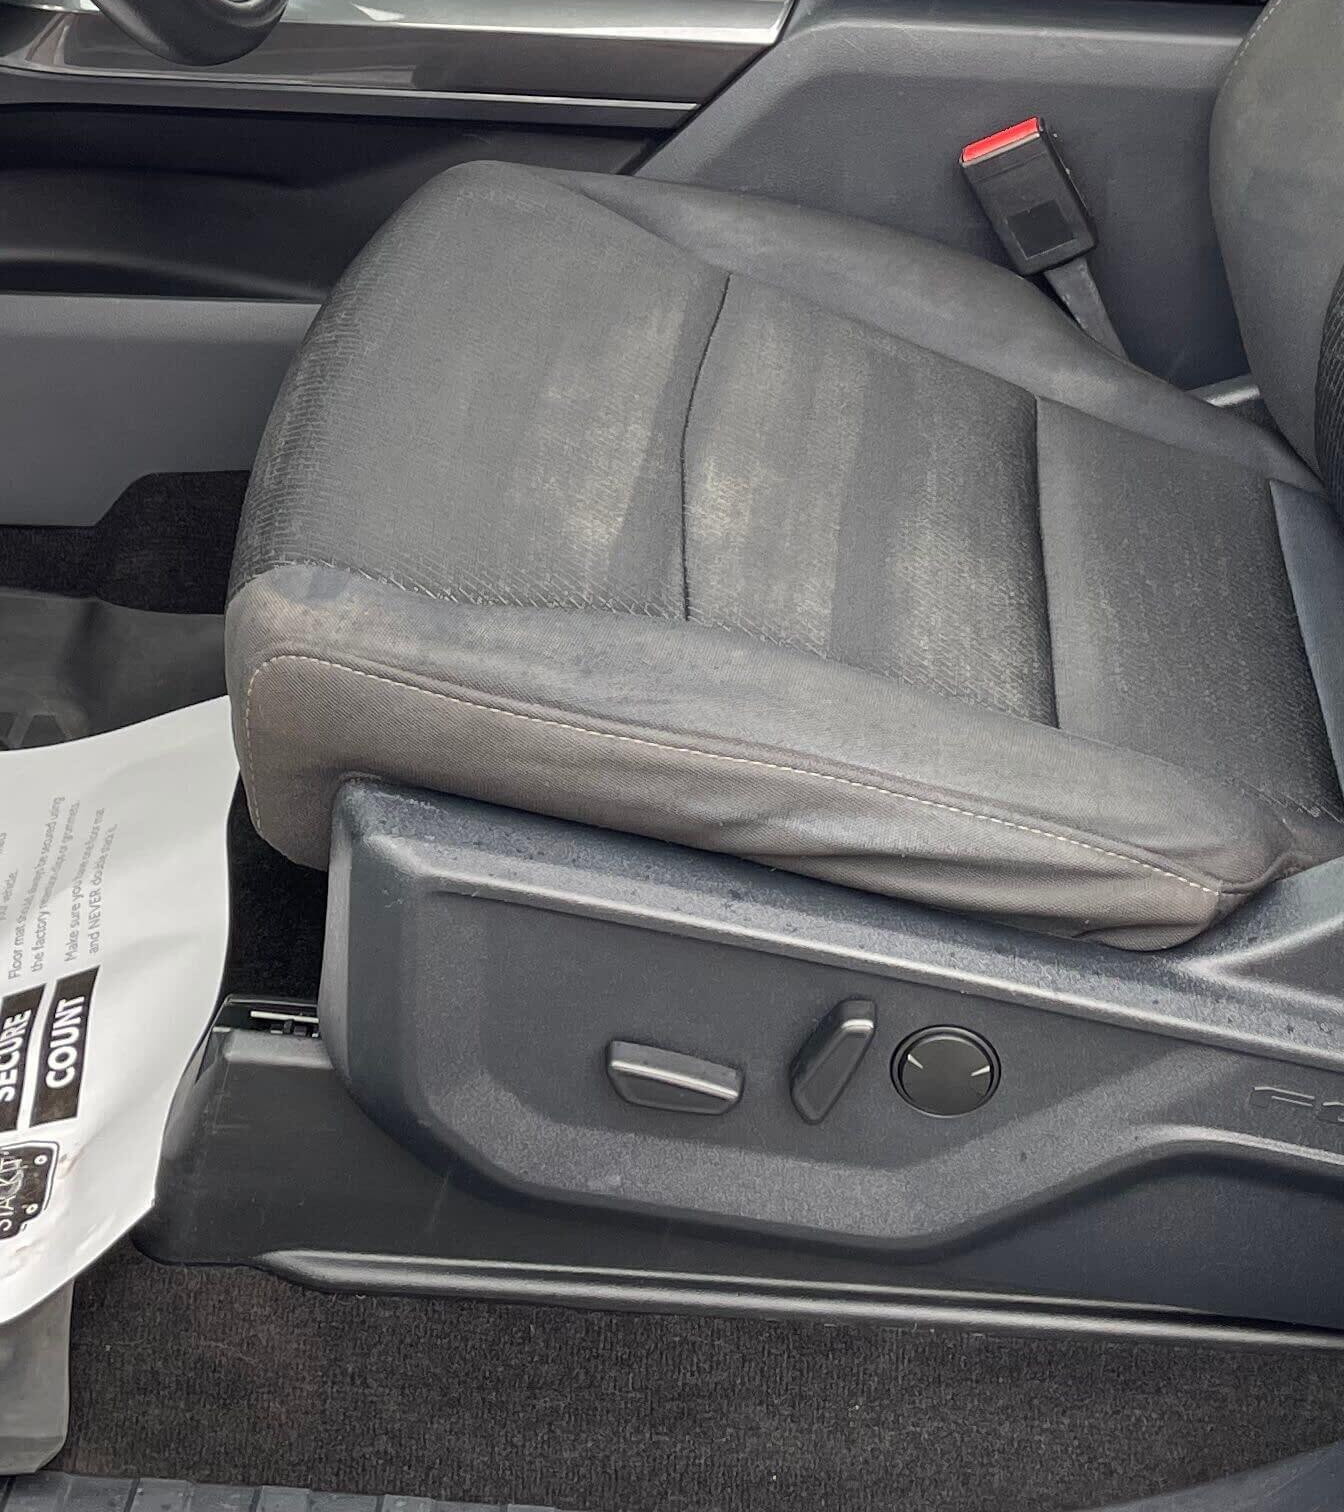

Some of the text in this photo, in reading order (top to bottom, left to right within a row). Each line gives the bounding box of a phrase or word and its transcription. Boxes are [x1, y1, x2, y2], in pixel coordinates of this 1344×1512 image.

[72, 879, 84, 902] you
[70, 902, 81, 928] sure
[88, 888, 102, 930] NEVER
[14, 924, 26, 946] mat
[31, 911, 50, 951] factory
[88, 931, 100, 954] and
[64, 930, 79, 962] Make
[8, 949, 23, 980] Floor
[30, 951, 44, 972] the
[45, 995, 85, 1089] COUNT
